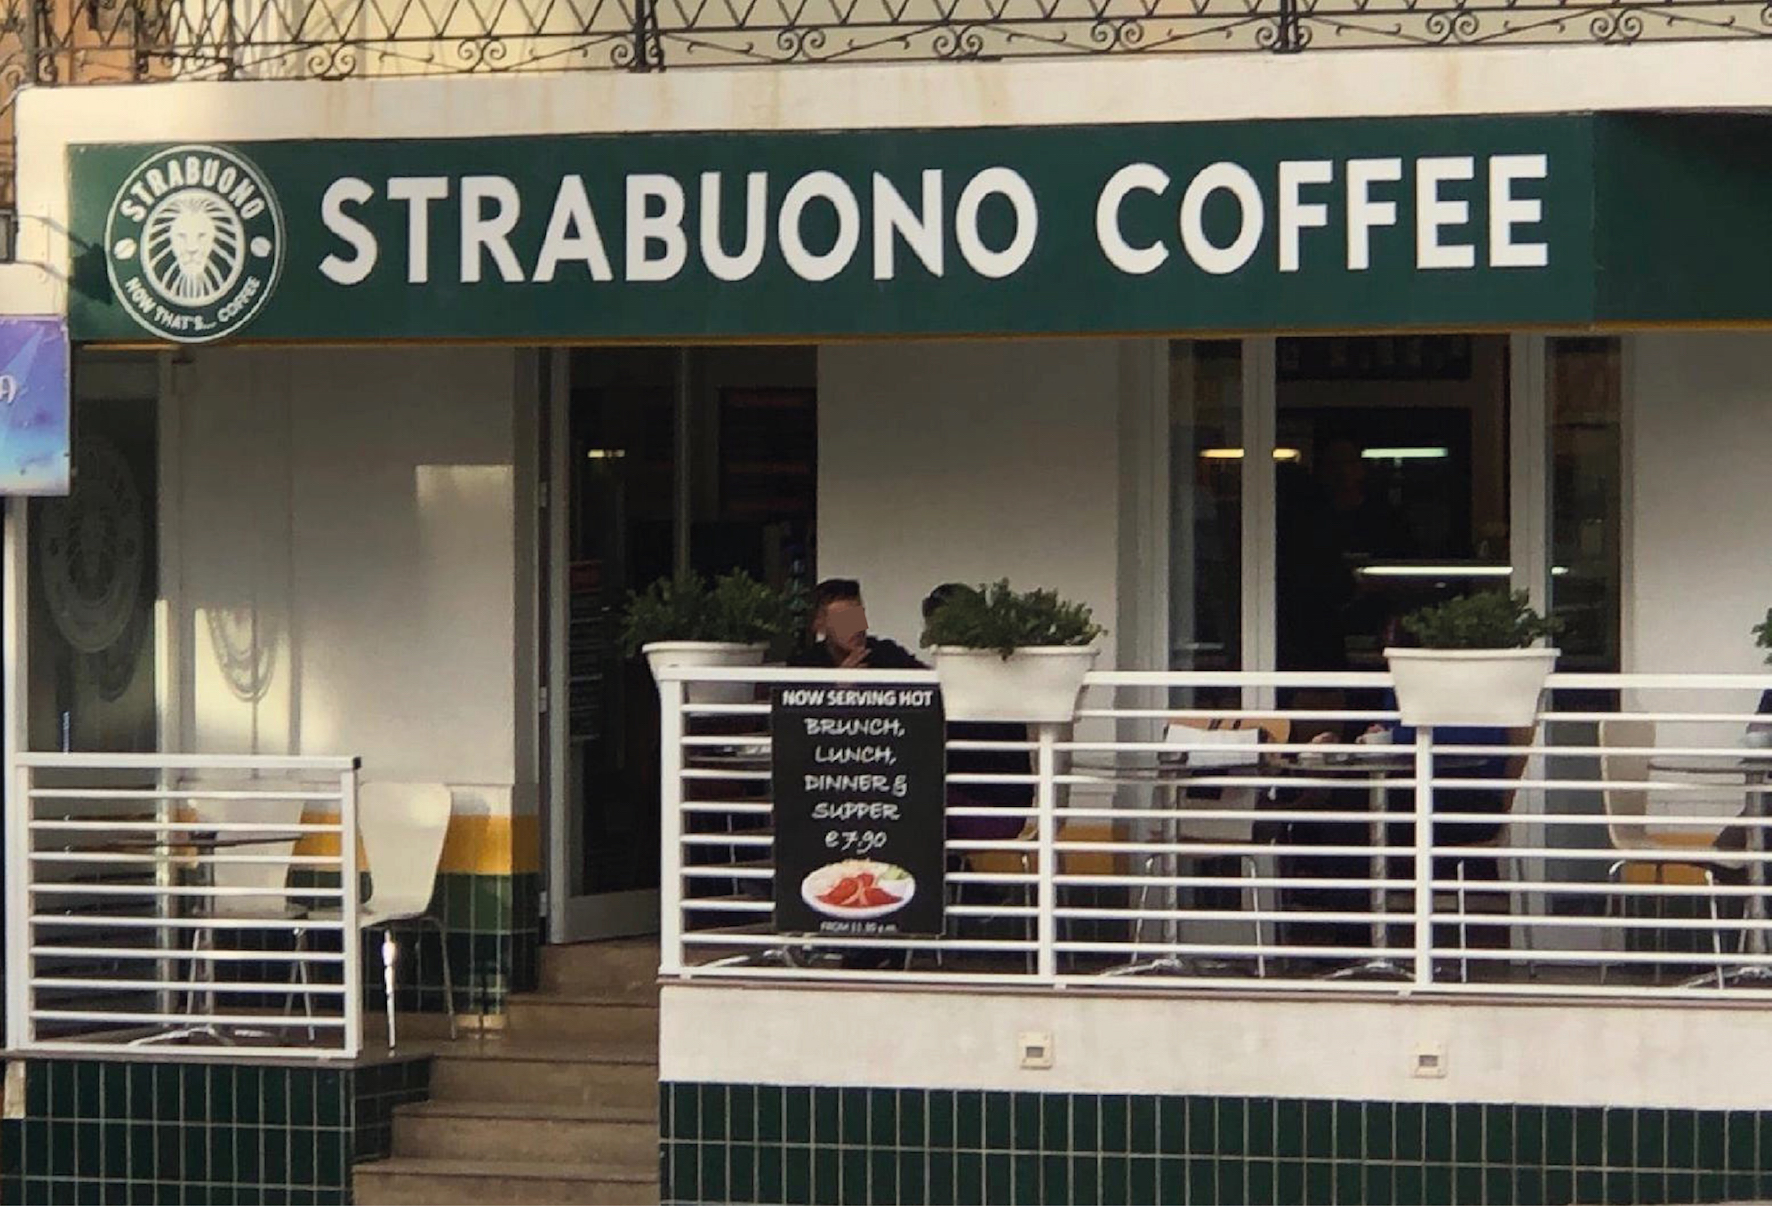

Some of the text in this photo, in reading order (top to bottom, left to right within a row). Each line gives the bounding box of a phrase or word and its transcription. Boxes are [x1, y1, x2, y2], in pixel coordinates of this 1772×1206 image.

[120, 156, 265, 222] STRABUONO
[319, 154, 1548, 285] STRABUONO COFFEE
[125, 277, 156, 313] NOW
[783, 690, 933, 706] NOW SERVING HOT
[804, 718, 905, 737] BRUNCH,
[815, 746, 897, 765] LUNCH,
[804, 775, 907, 797] DINNER &
[812, 802, 901, 820] SUPPER
